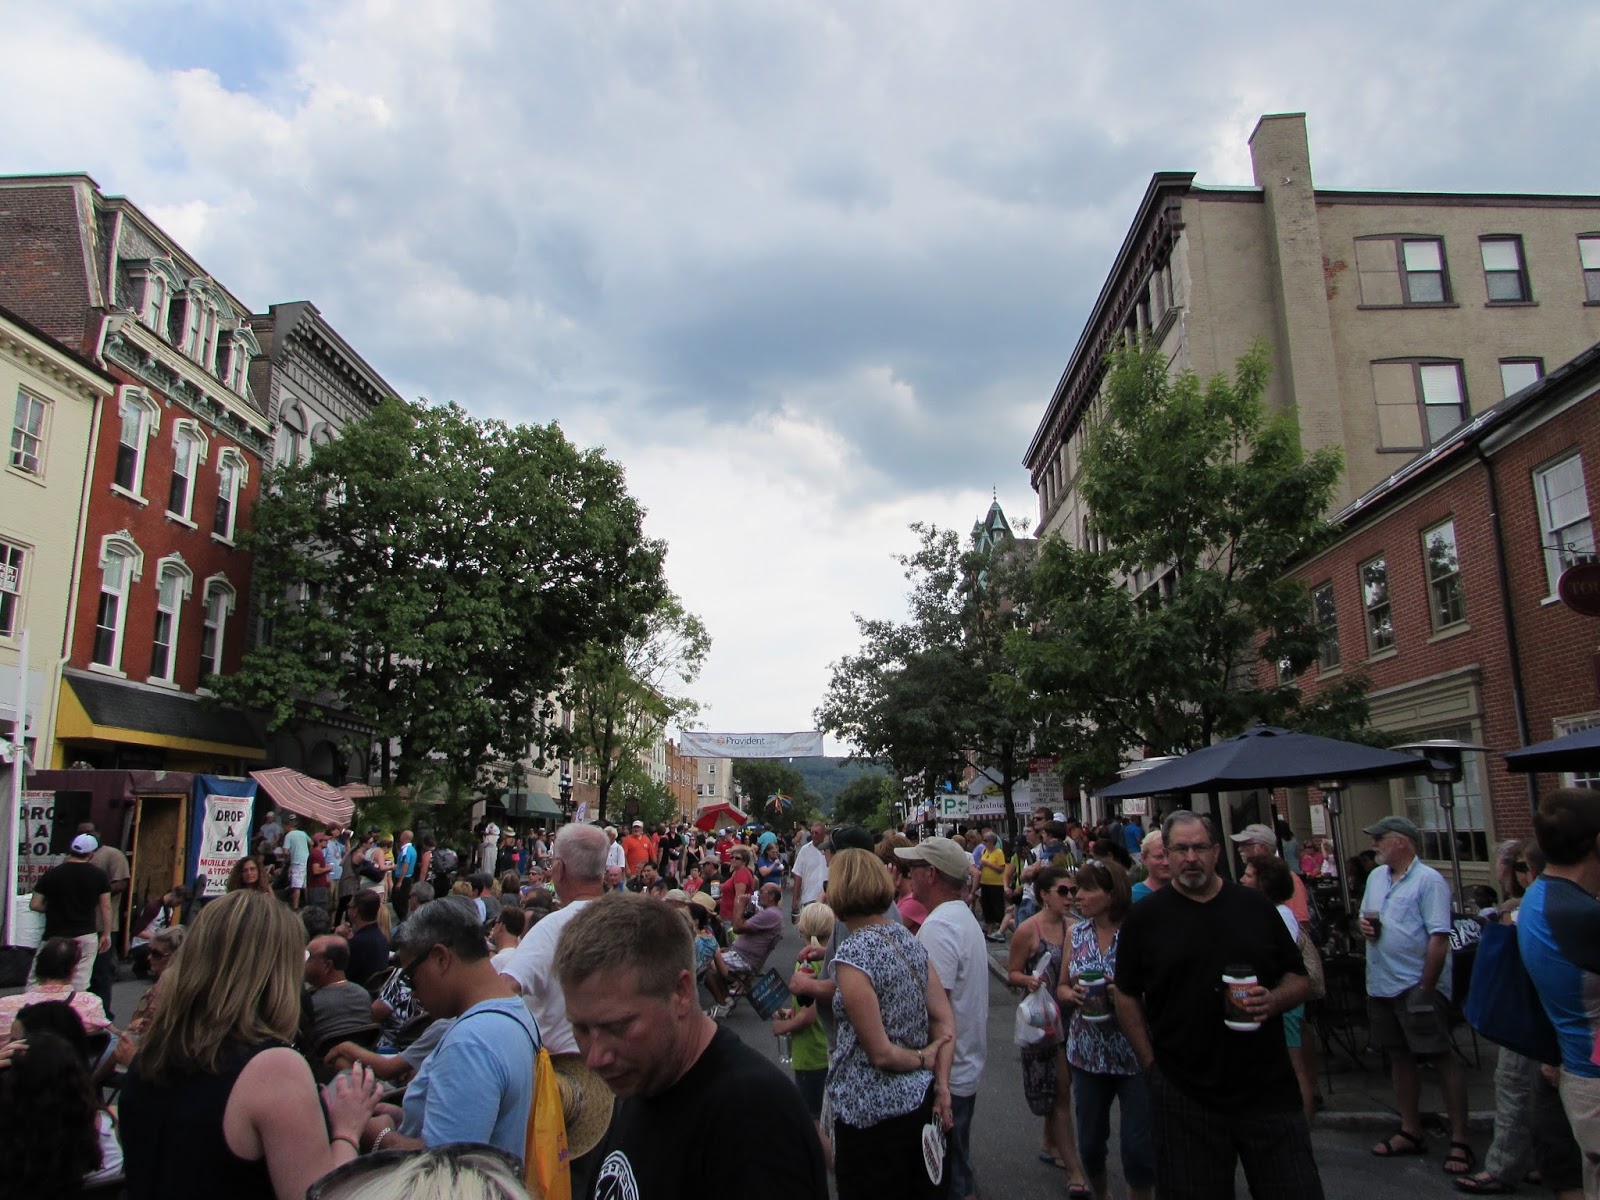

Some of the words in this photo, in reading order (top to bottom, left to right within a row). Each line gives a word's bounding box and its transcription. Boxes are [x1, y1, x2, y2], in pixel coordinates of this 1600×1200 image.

[726, 736, 765, 745] Provident
[20, 807, 56, 820] DRO
[215, 810, 245, 822] DROP
[35, 825, 49, 838] A
[226, 825, 235, 837] A
[216, 841, 240, 852] BOX
